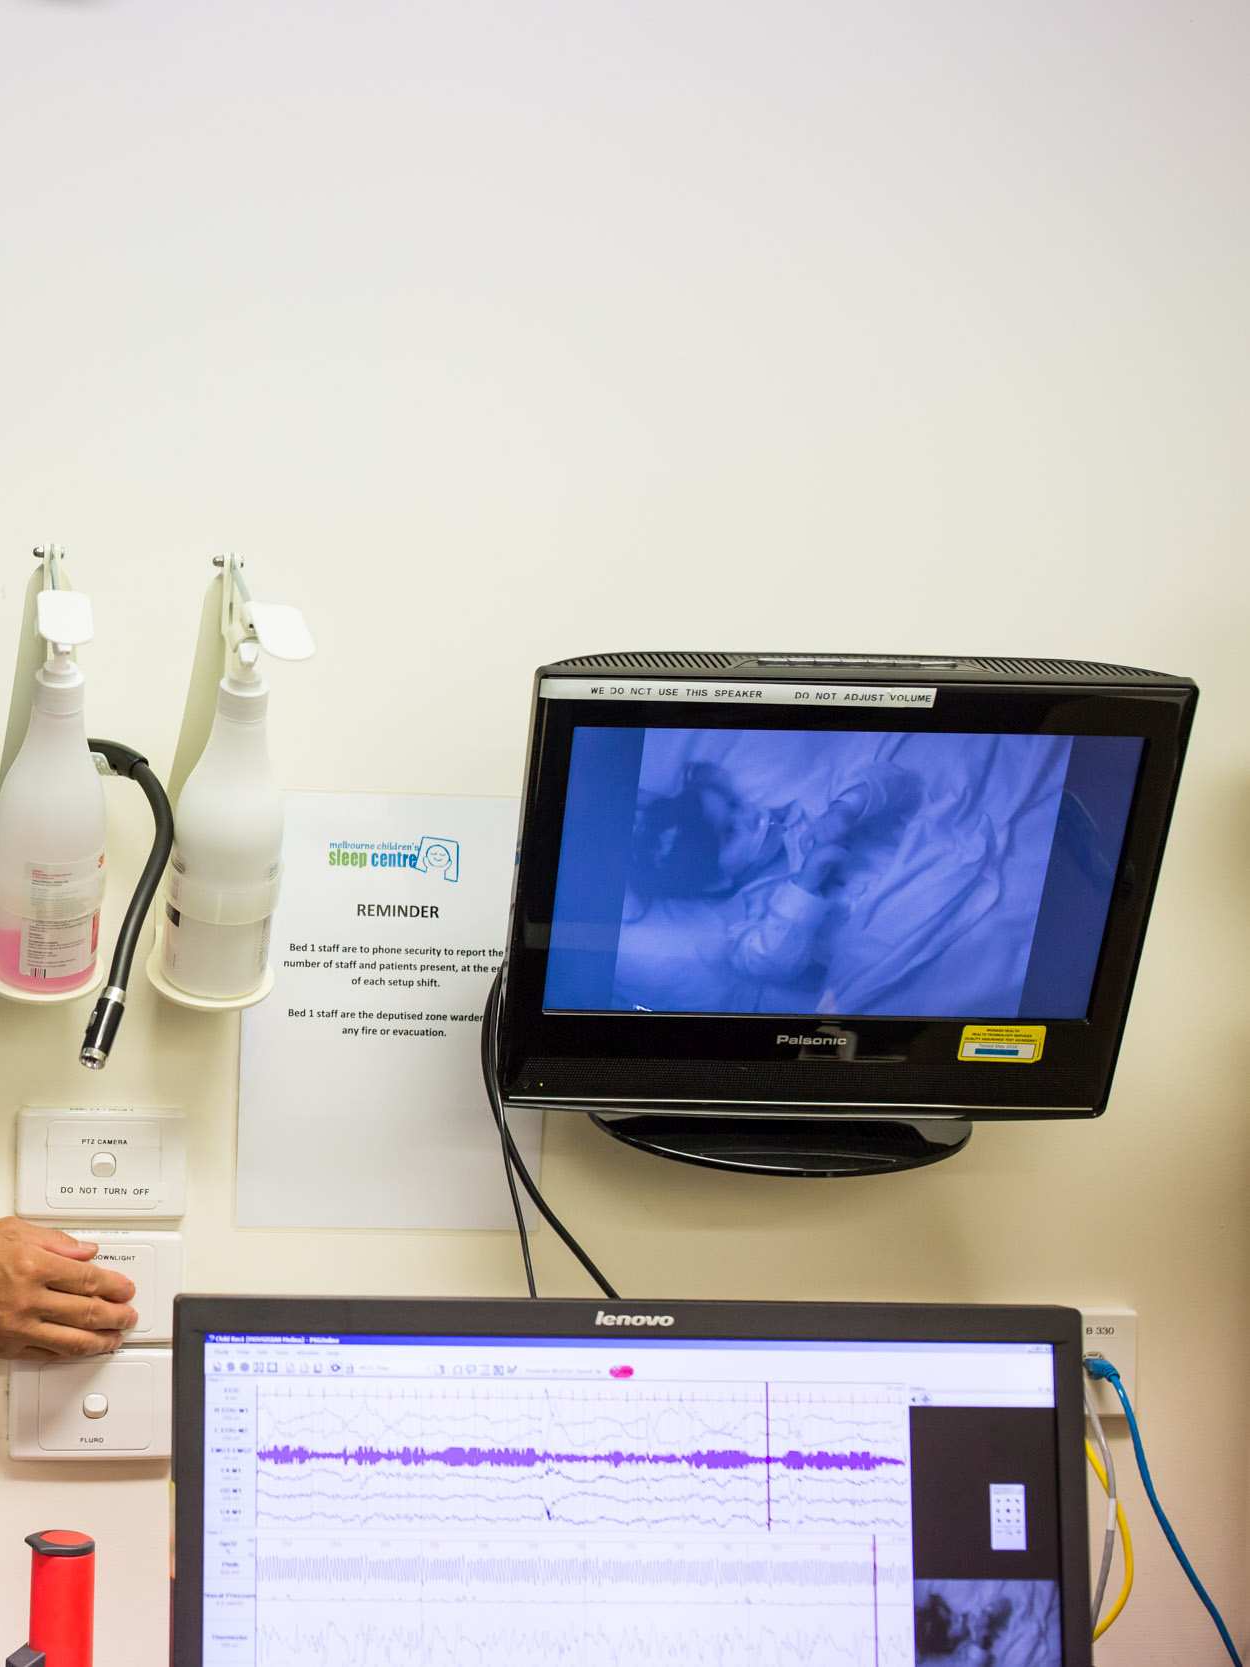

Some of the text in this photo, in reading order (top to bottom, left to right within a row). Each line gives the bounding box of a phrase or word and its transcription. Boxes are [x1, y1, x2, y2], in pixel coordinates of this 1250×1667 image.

[590, 687, 604, 695] WE
[658, 688, 679, 696] USE
[686, 689, 708, 697] THIS
[714, 690, 763, 698] SPEAKER
[794, 691, 810, 700] DO
[815, 692, 837, 700] NOT
[844, 693, 884, 702] ADJUST
[889, 694, 932, 703] VOLUME
[329, 841, 374, 849] melbourne
[329, 850, 417, 868] sleep centre
[357, 904, 439, 918] REMINDER
[290, 943, 308, 952] Bed
[311, 944, 316, 952] 1
[318, 944, 340, 953] staff
[360, 945, 370, 953] to
[372, 945, 402, 955] phone
[405, 947, 441, 957] security
[444, 948, 454, 956] to
[456, 949, 486, 958] report
[488, 948, 504, 957] the
[283, 960, 320, 968] number
[323, 960, 332, 968] of
[335, 960, 357, 969] staff
[359, 961, 377, 969] and
[379, 962, 417, 971] patients
[420, 963, 458, 973] present,
[461, 964, 471, 972] at
[473, 963, 489, 972] the
[351, 977, 440, 988] of each setup shift.
[288, 1009, 306, 1017] Bed
[317, 1009, 338, 1018] staff
[358, 1010, 374, 1019] the
[376, 1010, 423, 1021] deputised
[342, 1027, 359, 1036] any
[362, 1026, 377, 1035] fire
[393, 1028, 446, 1037] evacuation.
[776, 1034, 847, 1045] Palsonic
[60, 1186, 74, 1194] DO
[103, 1187, 127, 1195] TURN
[132, 1188, 150, 1196] OFF
[595, 1310, 675, 1326] lenovo
